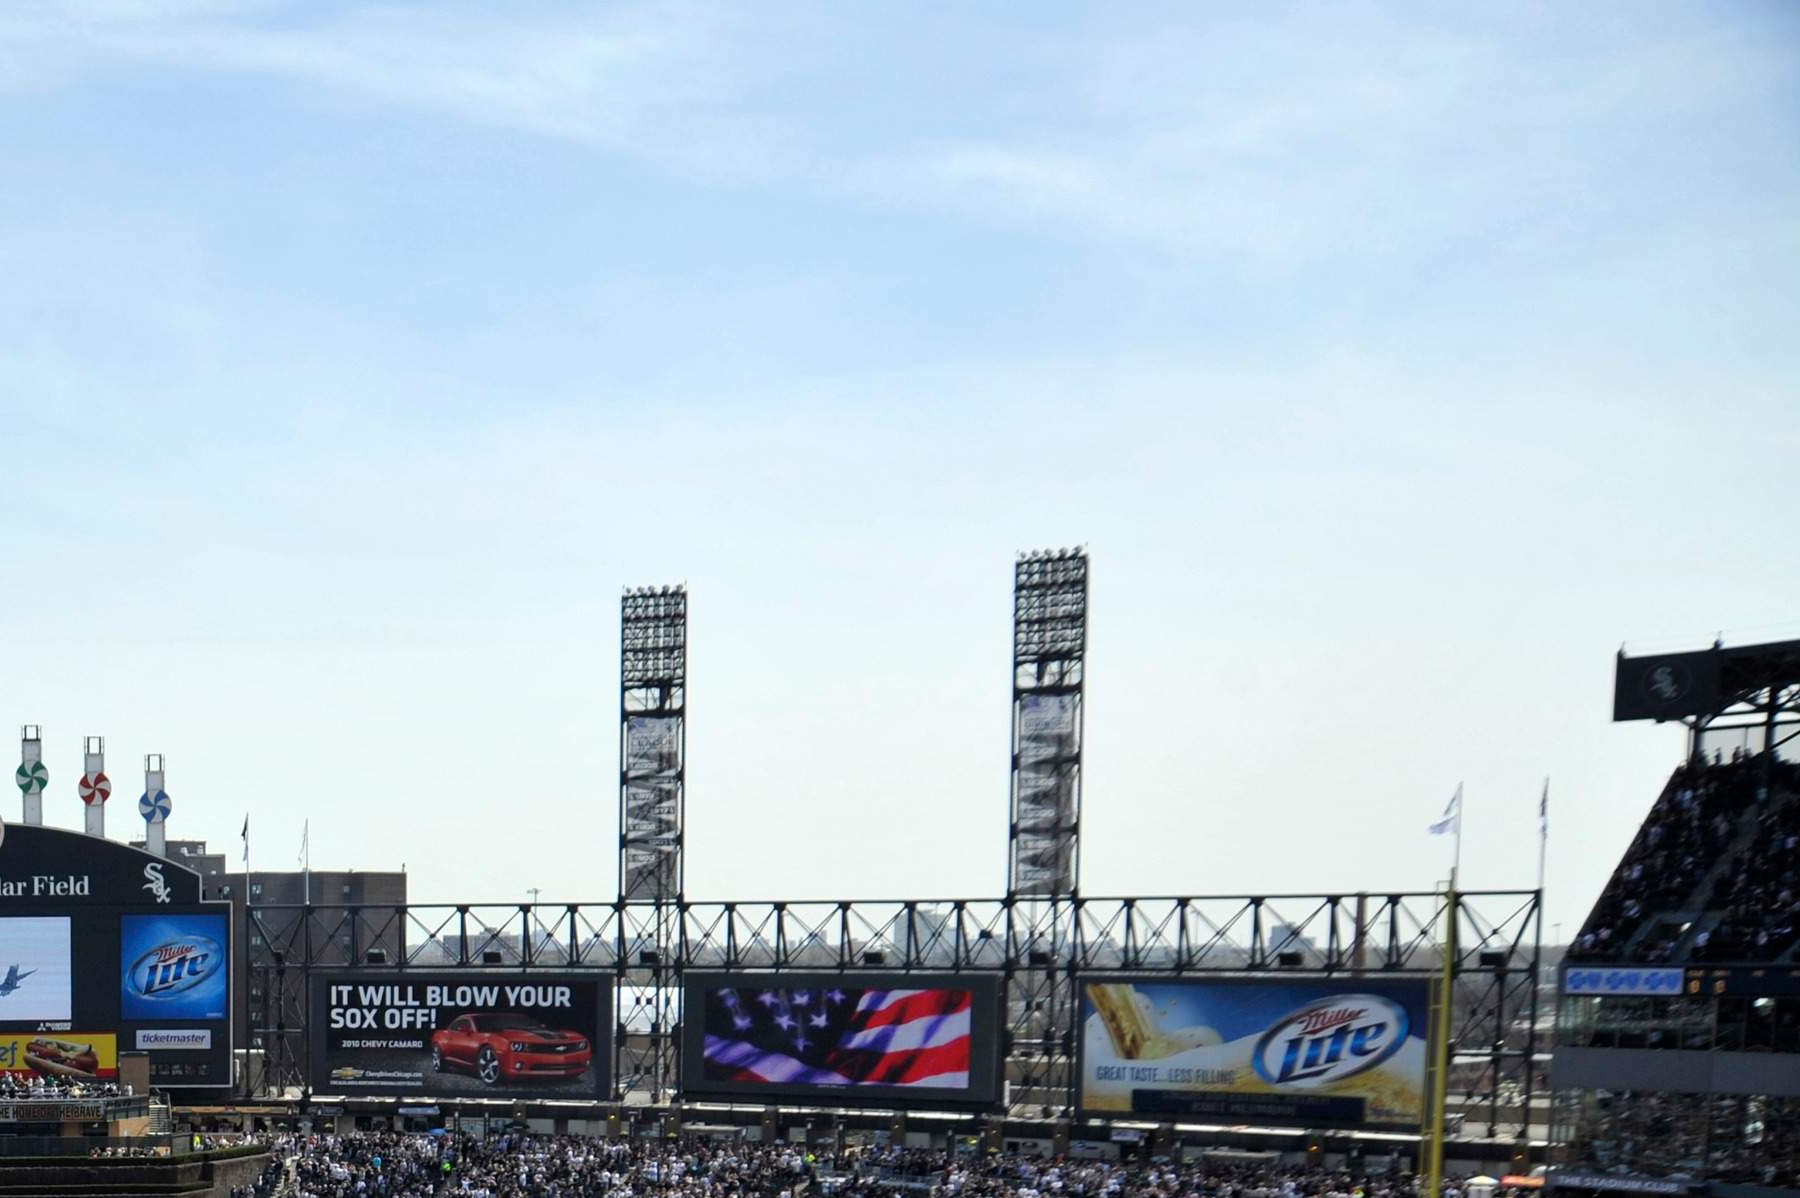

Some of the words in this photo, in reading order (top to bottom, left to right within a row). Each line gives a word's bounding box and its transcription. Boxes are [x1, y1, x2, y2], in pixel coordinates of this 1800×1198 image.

[32, 875, 90, 896] Field
[155, 944, 196, 962] Miller
[144, 953, 209, 995] Lite
[330, 986, 352, 1006] IT
[358, 986, 420, 1006] WILL
[426, 986, 499, 1007] BLOW
[505, 986, 571, 1007] YOUR
[330, 1008, 378, 1029] SOX
[384, 1008, 437, 1029] OFF!
[1300, 1008, 1368, 1030] Miller
[141, 1033, 206, 1044] ticketmaster
[342, 1040, 360, 1049] 2010
[361, 1040, 387, 1049] CHEVY
[388, 1040, 423, 1049] CAMARO
[1276, 1023, 1388, 1083] Lite
[1096, 1066, 1126, 1081] GREAT
[74, 1106, 102, 1118] BRAVE
